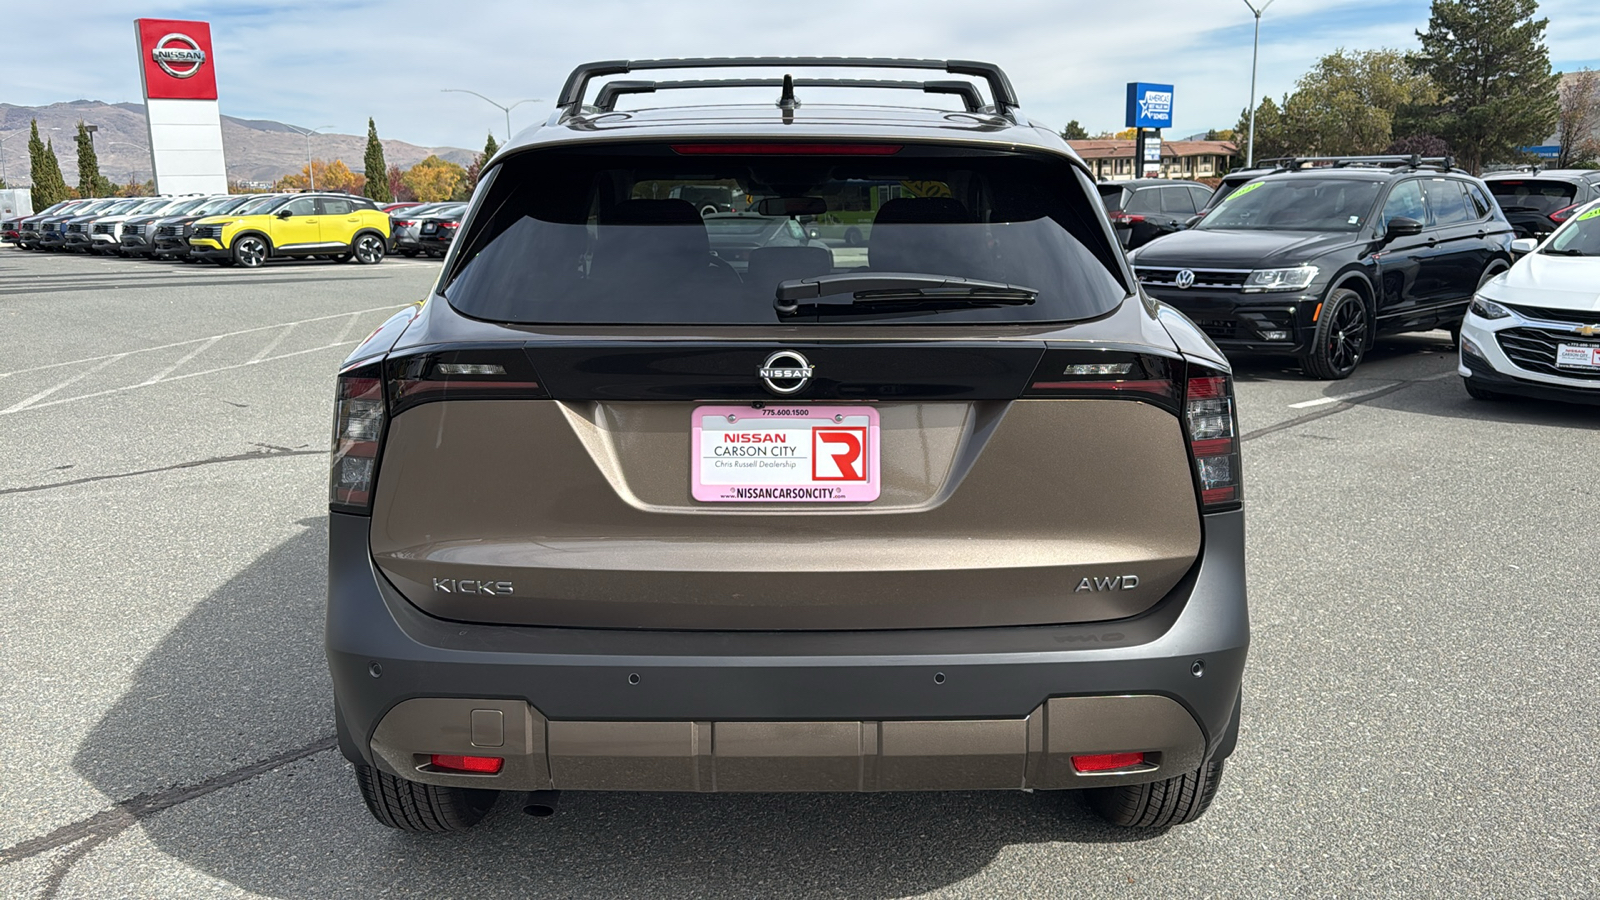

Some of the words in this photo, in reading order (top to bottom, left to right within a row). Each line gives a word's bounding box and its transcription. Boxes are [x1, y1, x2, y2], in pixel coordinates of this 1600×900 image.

[158, 51, 202, 60] NISSAN
[724, 433, 786, 443] NISSAN
[714, 446, 767, 456] CARSON
[771, 446, 796, 456] CITY
[759, 460, 796, 469] Dealership
[433, 578, 514, 595] KICKS
[1075, 575, 1139, 592] AWD
